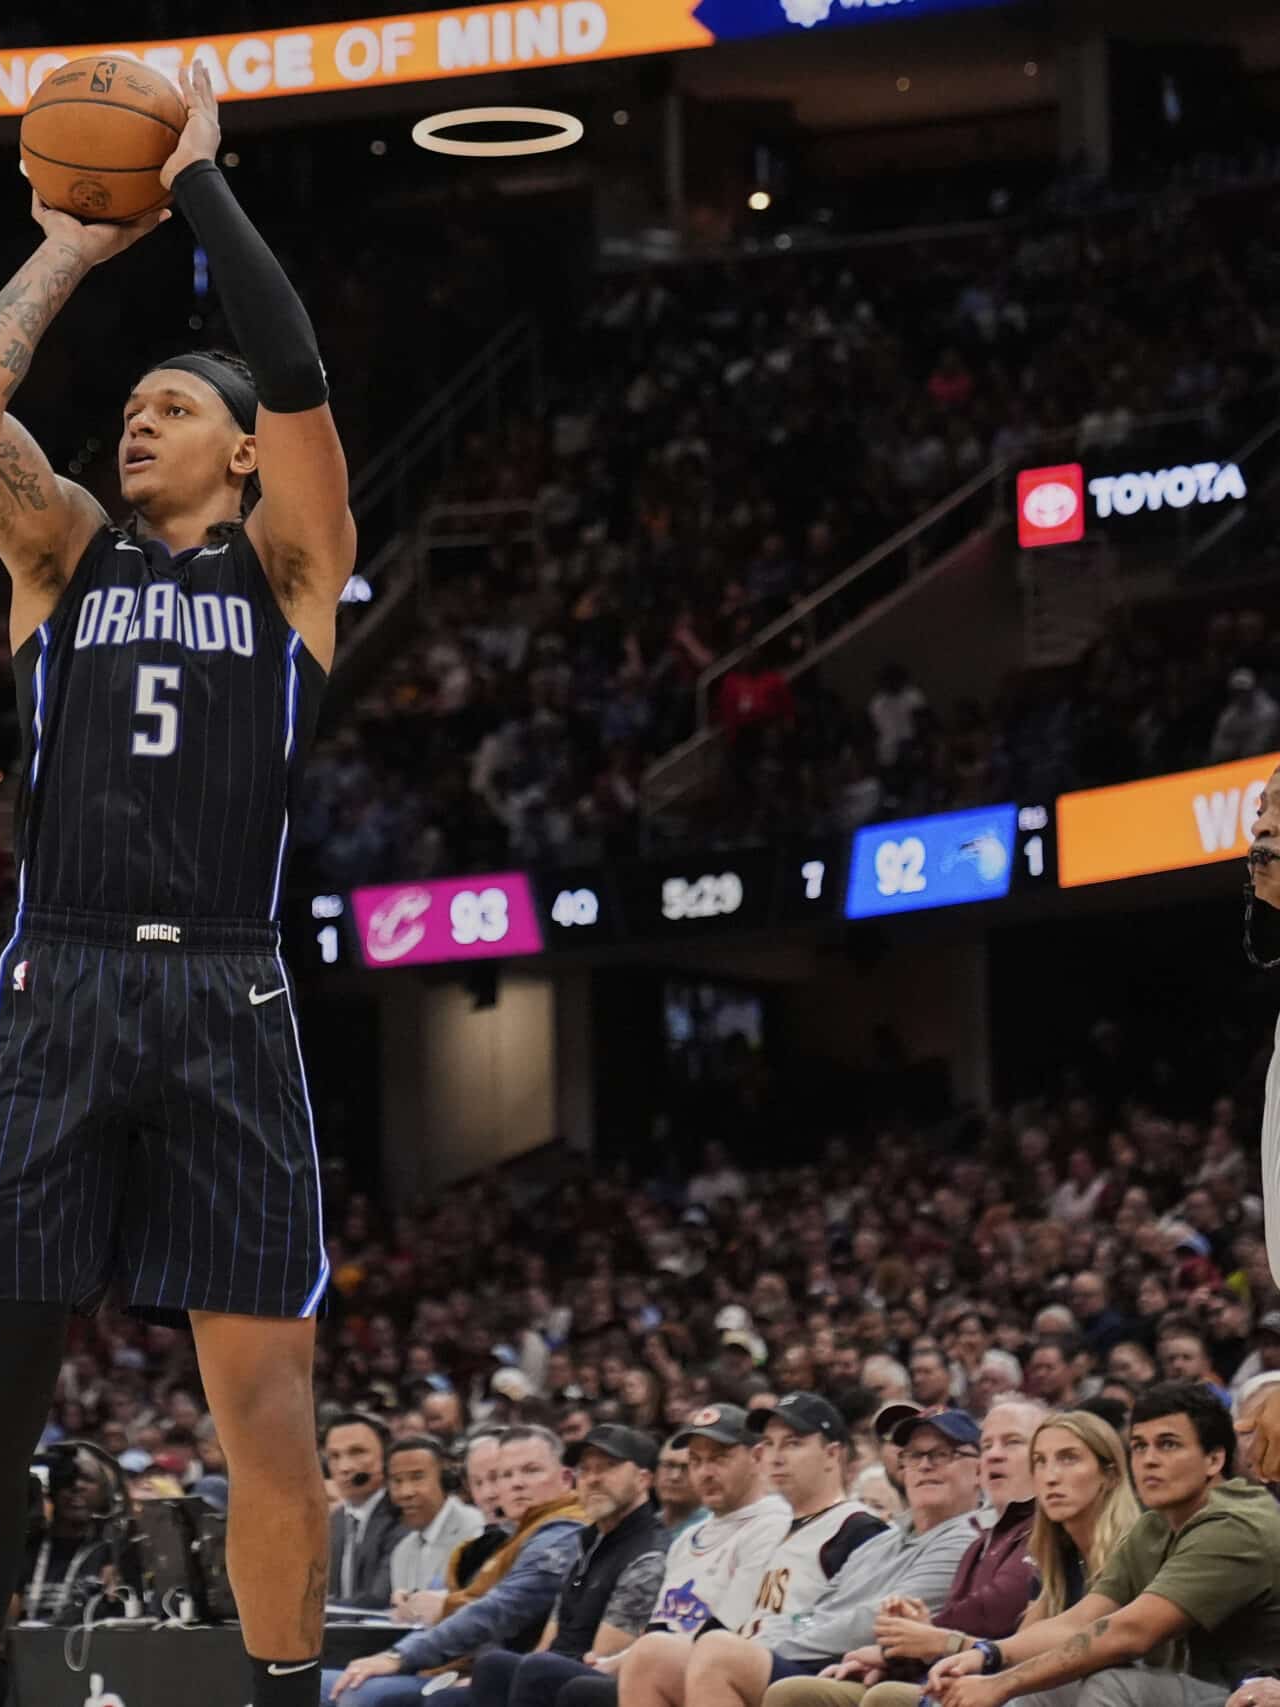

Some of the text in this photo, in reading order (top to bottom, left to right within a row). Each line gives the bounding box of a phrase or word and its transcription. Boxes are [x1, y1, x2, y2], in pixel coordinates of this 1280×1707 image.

[98, 34, 315, 98] EACE
[335, 22, 415, 81] OF
[437, 0, 608, 69] MIND
[1087, 461, 1248, 519] TOYOTA
[73, 581, 255, 657] ORLANDO
[131, 664, 181, 756] 5
[135, 923, 181, 944] MAGIC
[317, 926, 338, 963] 1
[450, 887, 509, 945] 93
[875, 837, 927, 896] 92
[1023, 835, 1044, 876] 1
